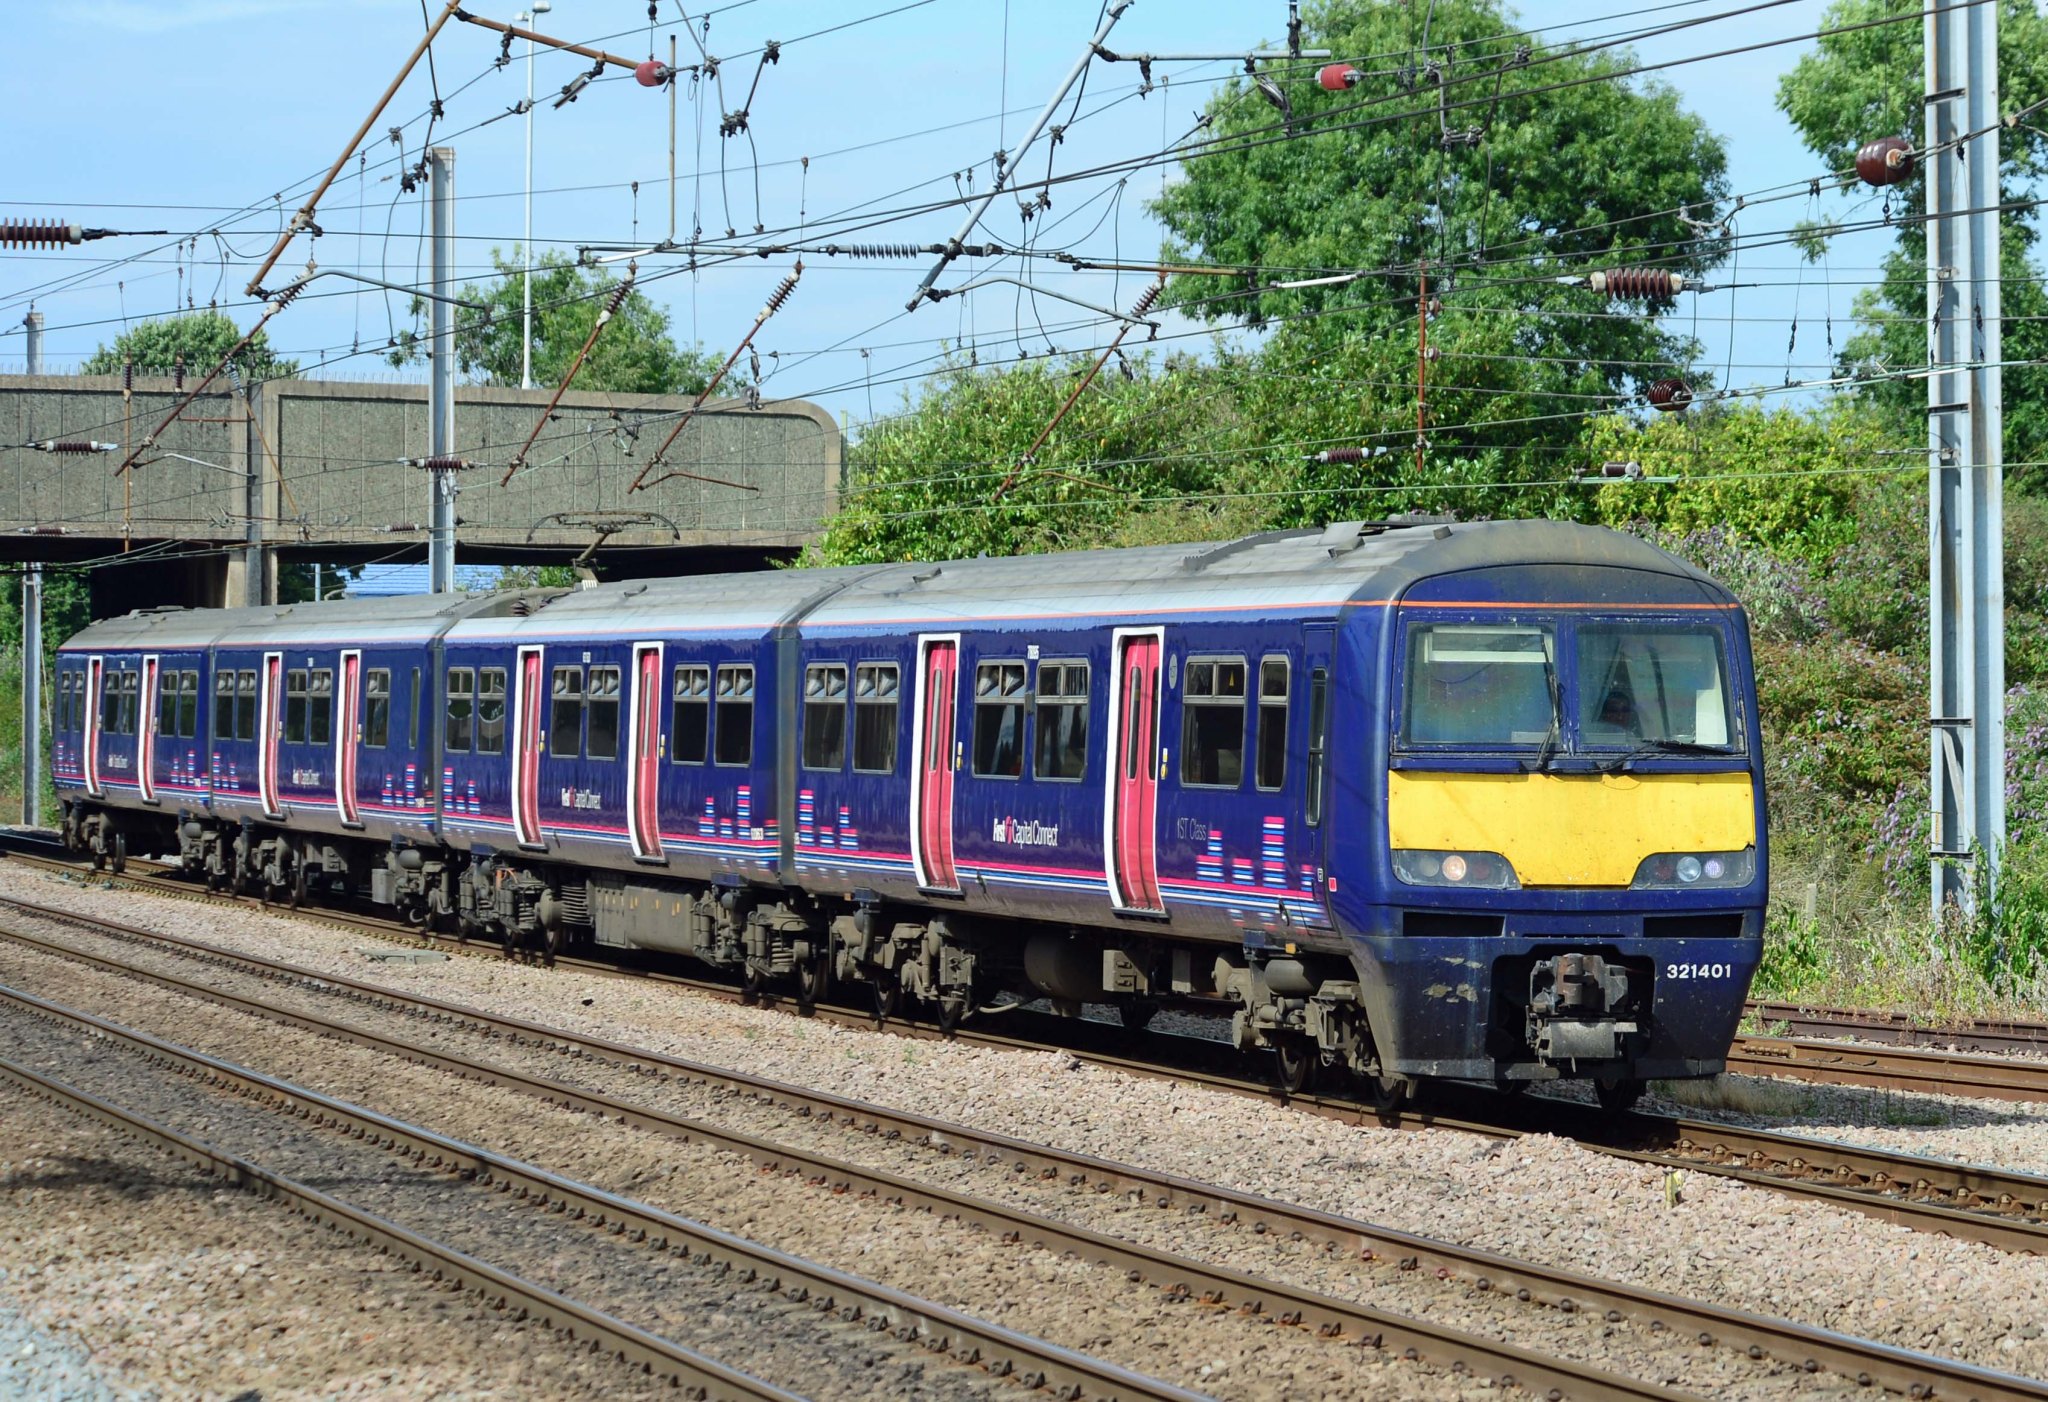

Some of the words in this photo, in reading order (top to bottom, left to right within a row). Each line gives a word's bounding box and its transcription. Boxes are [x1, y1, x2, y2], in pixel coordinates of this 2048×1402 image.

[993, 818, 1006, 843] First
[1012, 819, 1033, 850] Capital
[1033, 819, 1059, 847] Connect
[1177, 817, 1189, 840] 1ST
[1189, 818, 1207, 841] Class
[1667, 964, 1731, 979] 321401
